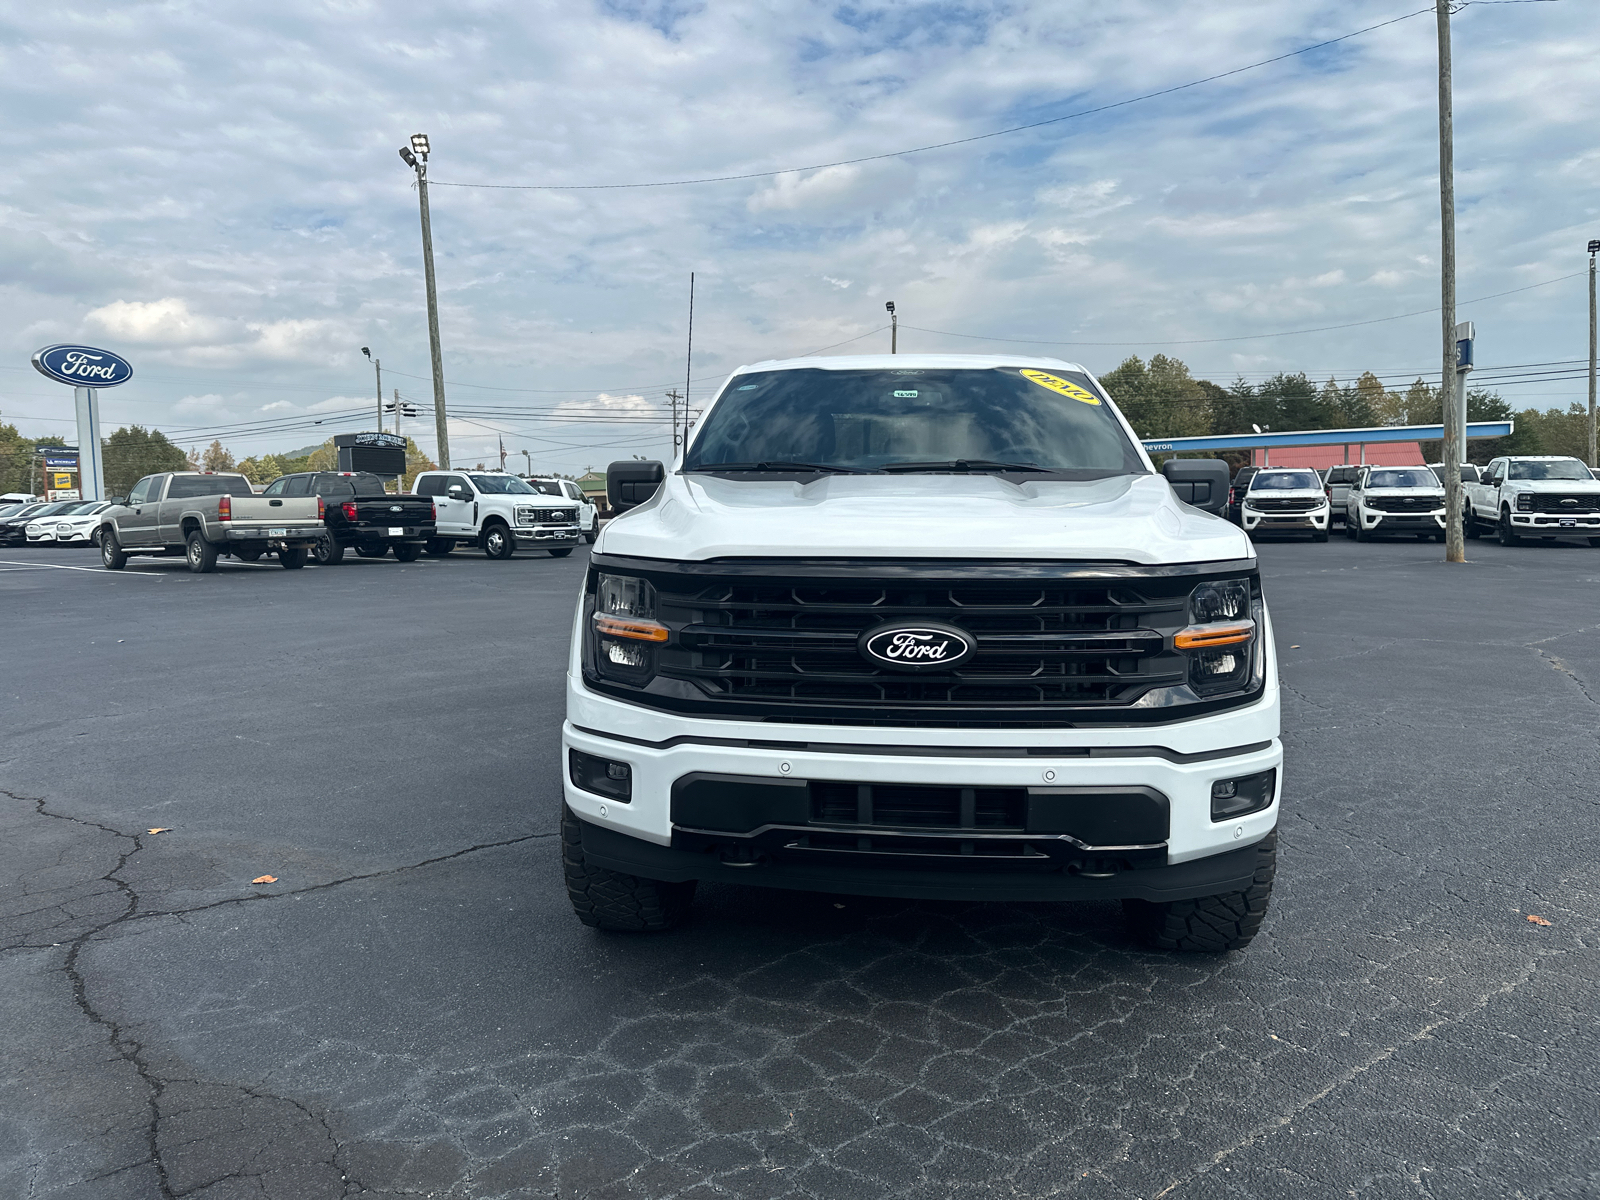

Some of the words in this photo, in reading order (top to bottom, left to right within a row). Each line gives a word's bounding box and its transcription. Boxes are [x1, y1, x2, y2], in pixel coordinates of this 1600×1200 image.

[61, 351, 117, 380] Ford
[1028, 373, 1095, 400] DEMO
[1143, 443, 1173, 451] hevron
[886, 632, 949, 659] Ford
